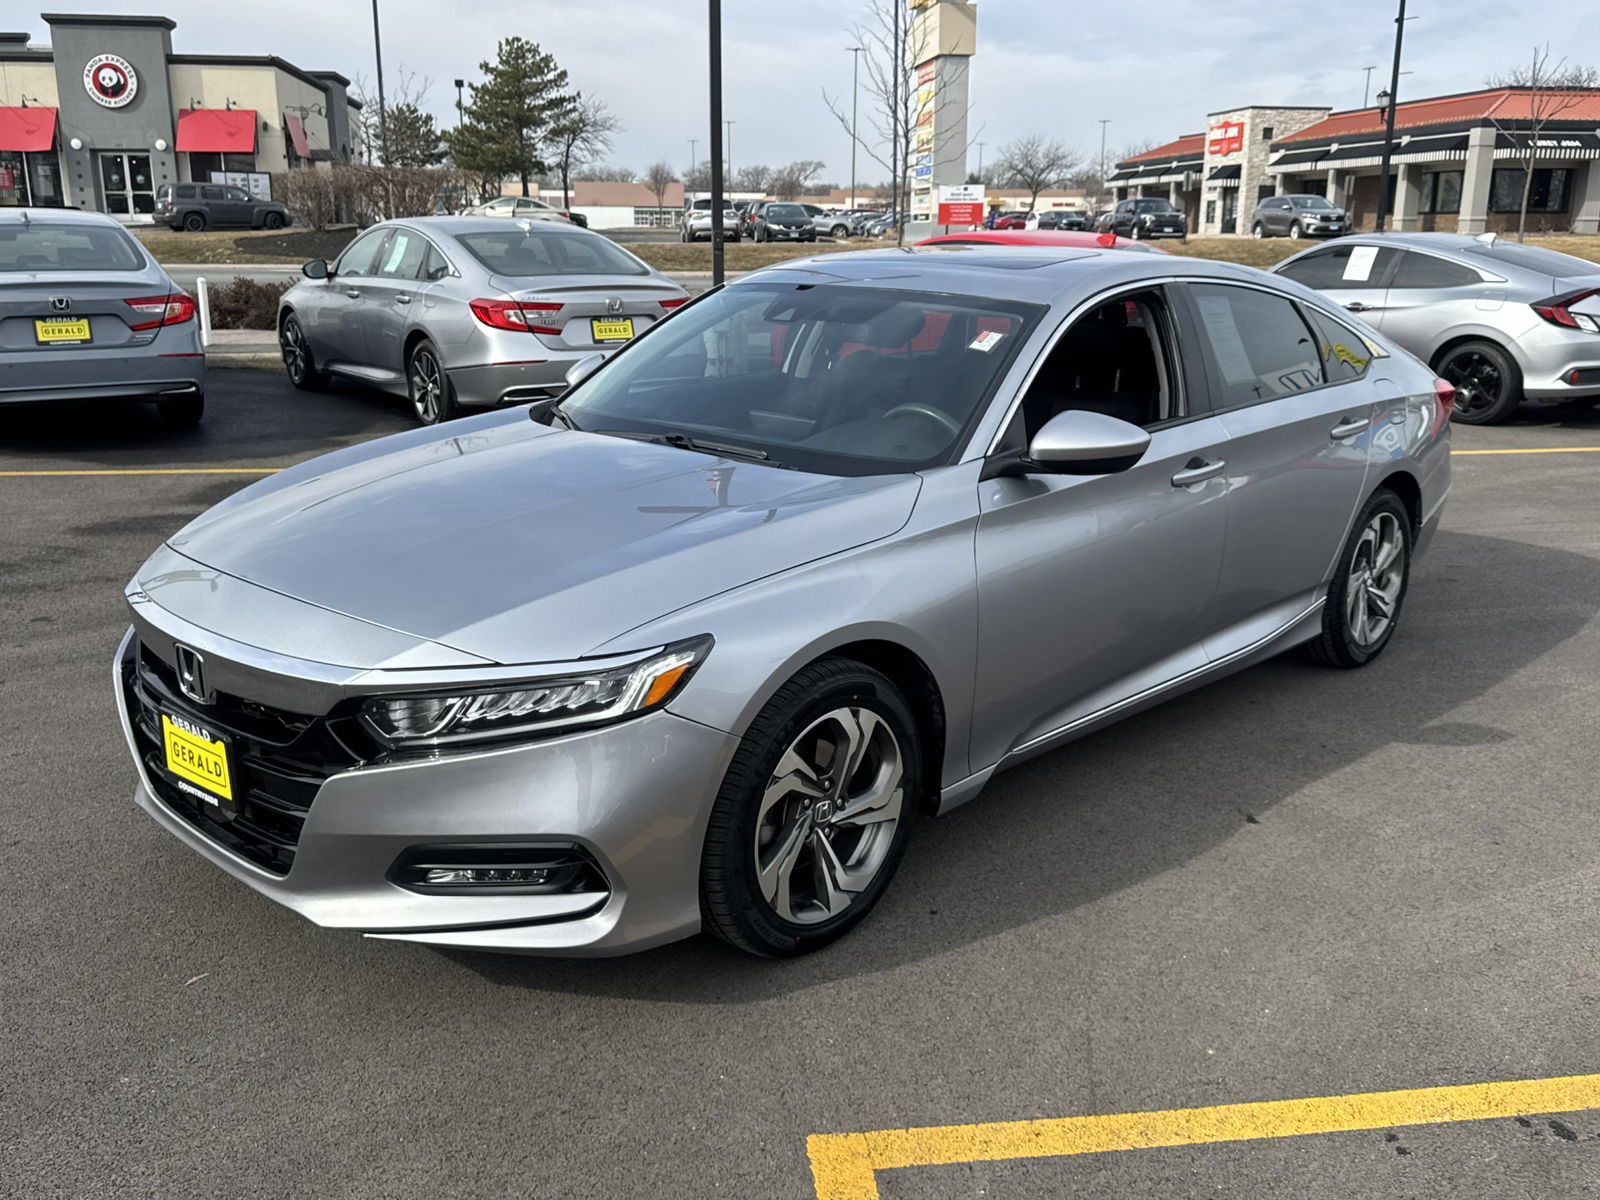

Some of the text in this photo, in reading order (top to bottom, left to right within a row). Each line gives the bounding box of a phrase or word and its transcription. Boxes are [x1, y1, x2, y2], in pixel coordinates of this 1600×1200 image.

[85, 56, 134, 79] PANDA EXPRESS
[88, 87, 134, 105] CHINESE KITCHEN
[44, 327, 83, 336] GERALD
[598, 326, 628, 334] GERALD
[171, 714, 211, 742] GERALD
[173, 741, 222, 778] GERALD
[178, 780, 219, 807] COUNTRYSIDE
